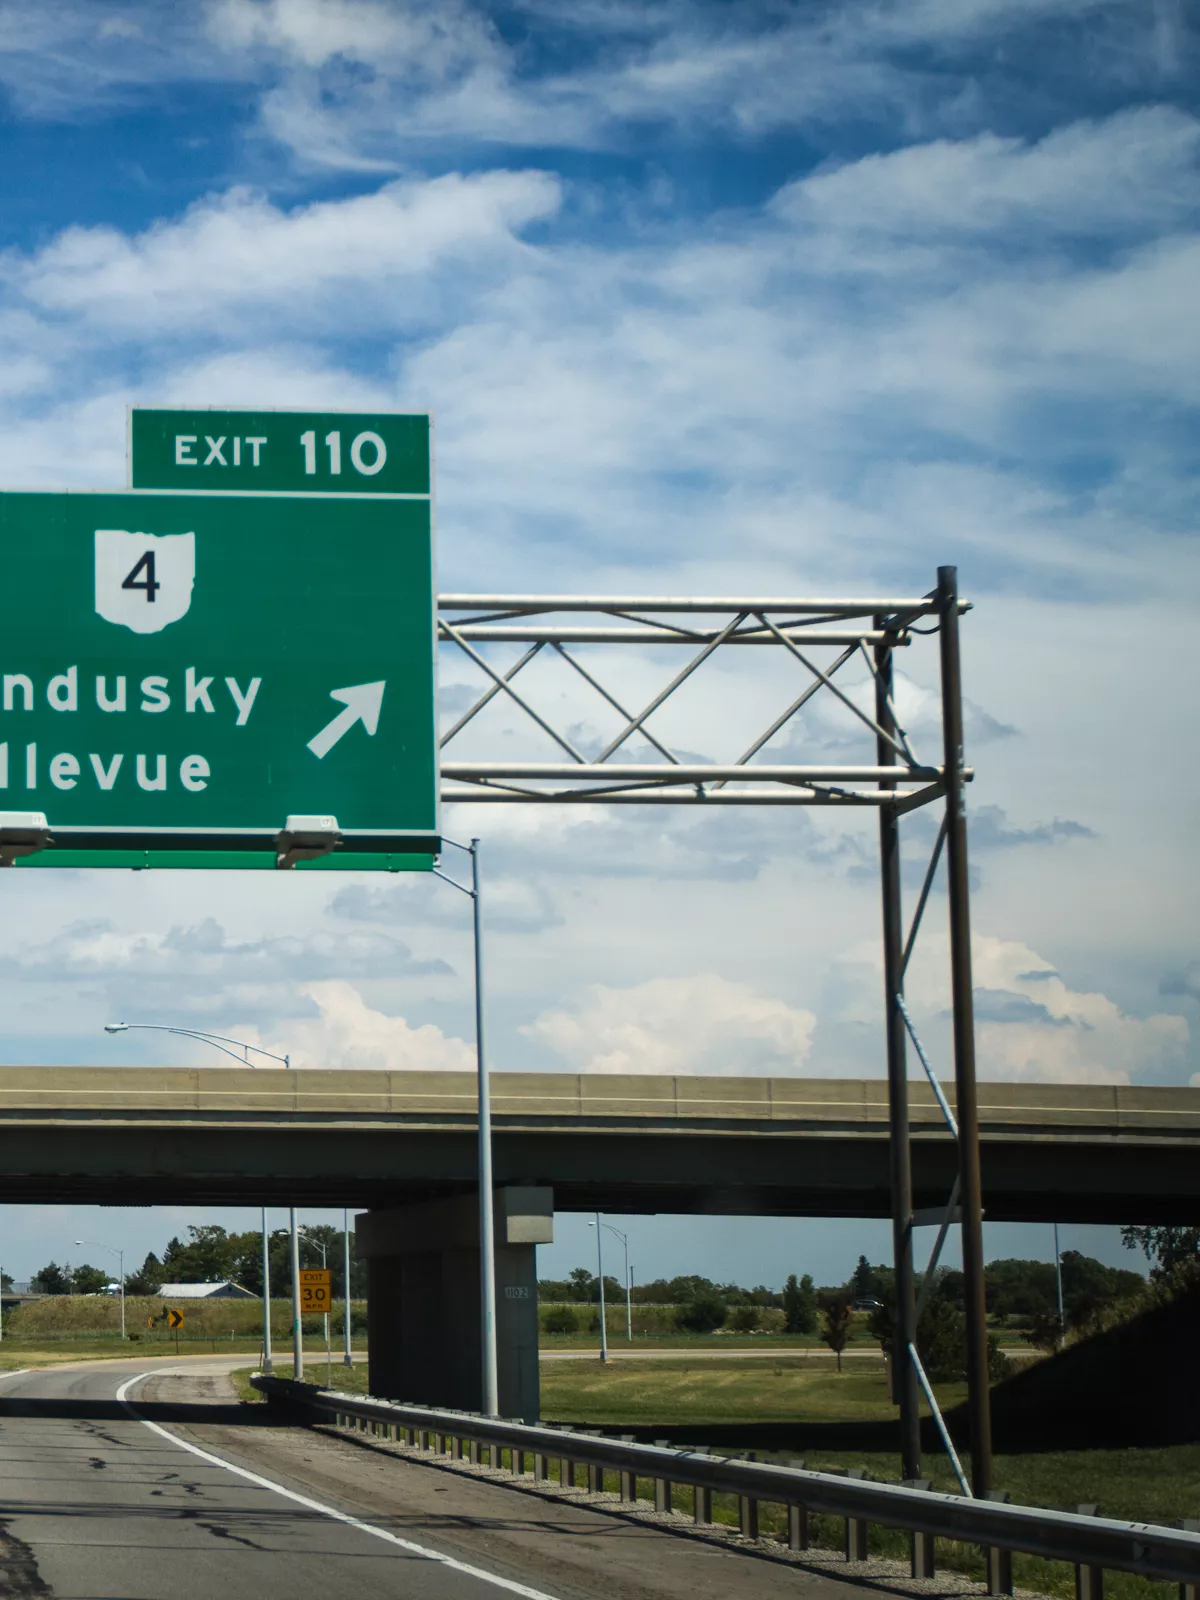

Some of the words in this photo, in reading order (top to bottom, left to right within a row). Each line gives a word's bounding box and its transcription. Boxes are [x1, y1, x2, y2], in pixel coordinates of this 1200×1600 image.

[175, 435, 268, 466] EXIT
[300, 430, 387, 476] 110
[121, 550, 161, 603] 4
[304, 1273, 323, 1281] EXIT
[303, 1287, 326, 1301] 30
